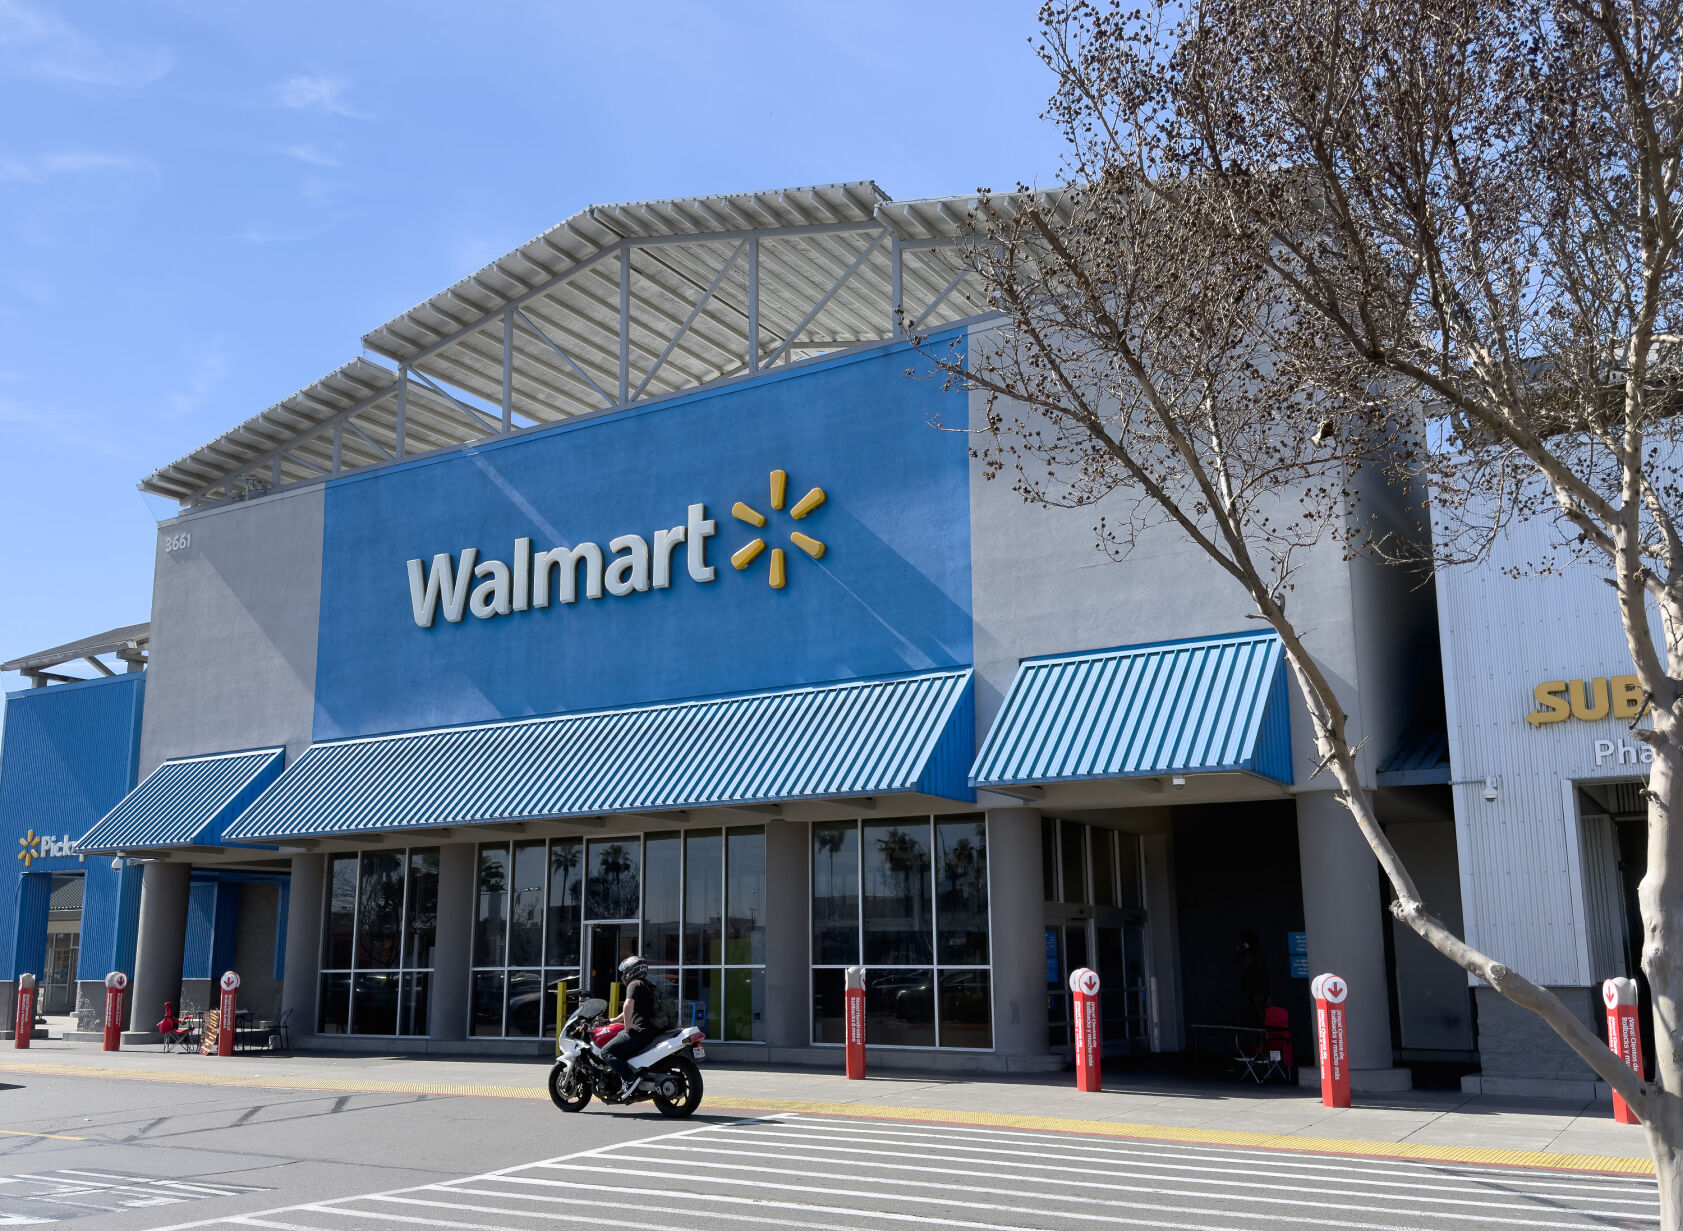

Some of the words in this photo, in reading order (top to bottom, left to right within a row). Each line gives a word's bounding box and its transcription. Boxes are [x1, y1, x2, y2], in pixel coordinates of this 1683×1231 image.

[165, 533, 191, 552] 3661
[406, 503, 716, 628] Walmart
[41, 834, 85, 862] Pick
[1621, 1016, 1629, 1048] Rollbacks
[1630, 1037, 1638, 1062] Cientos
[1632, 1062, 1639, 1072] de
